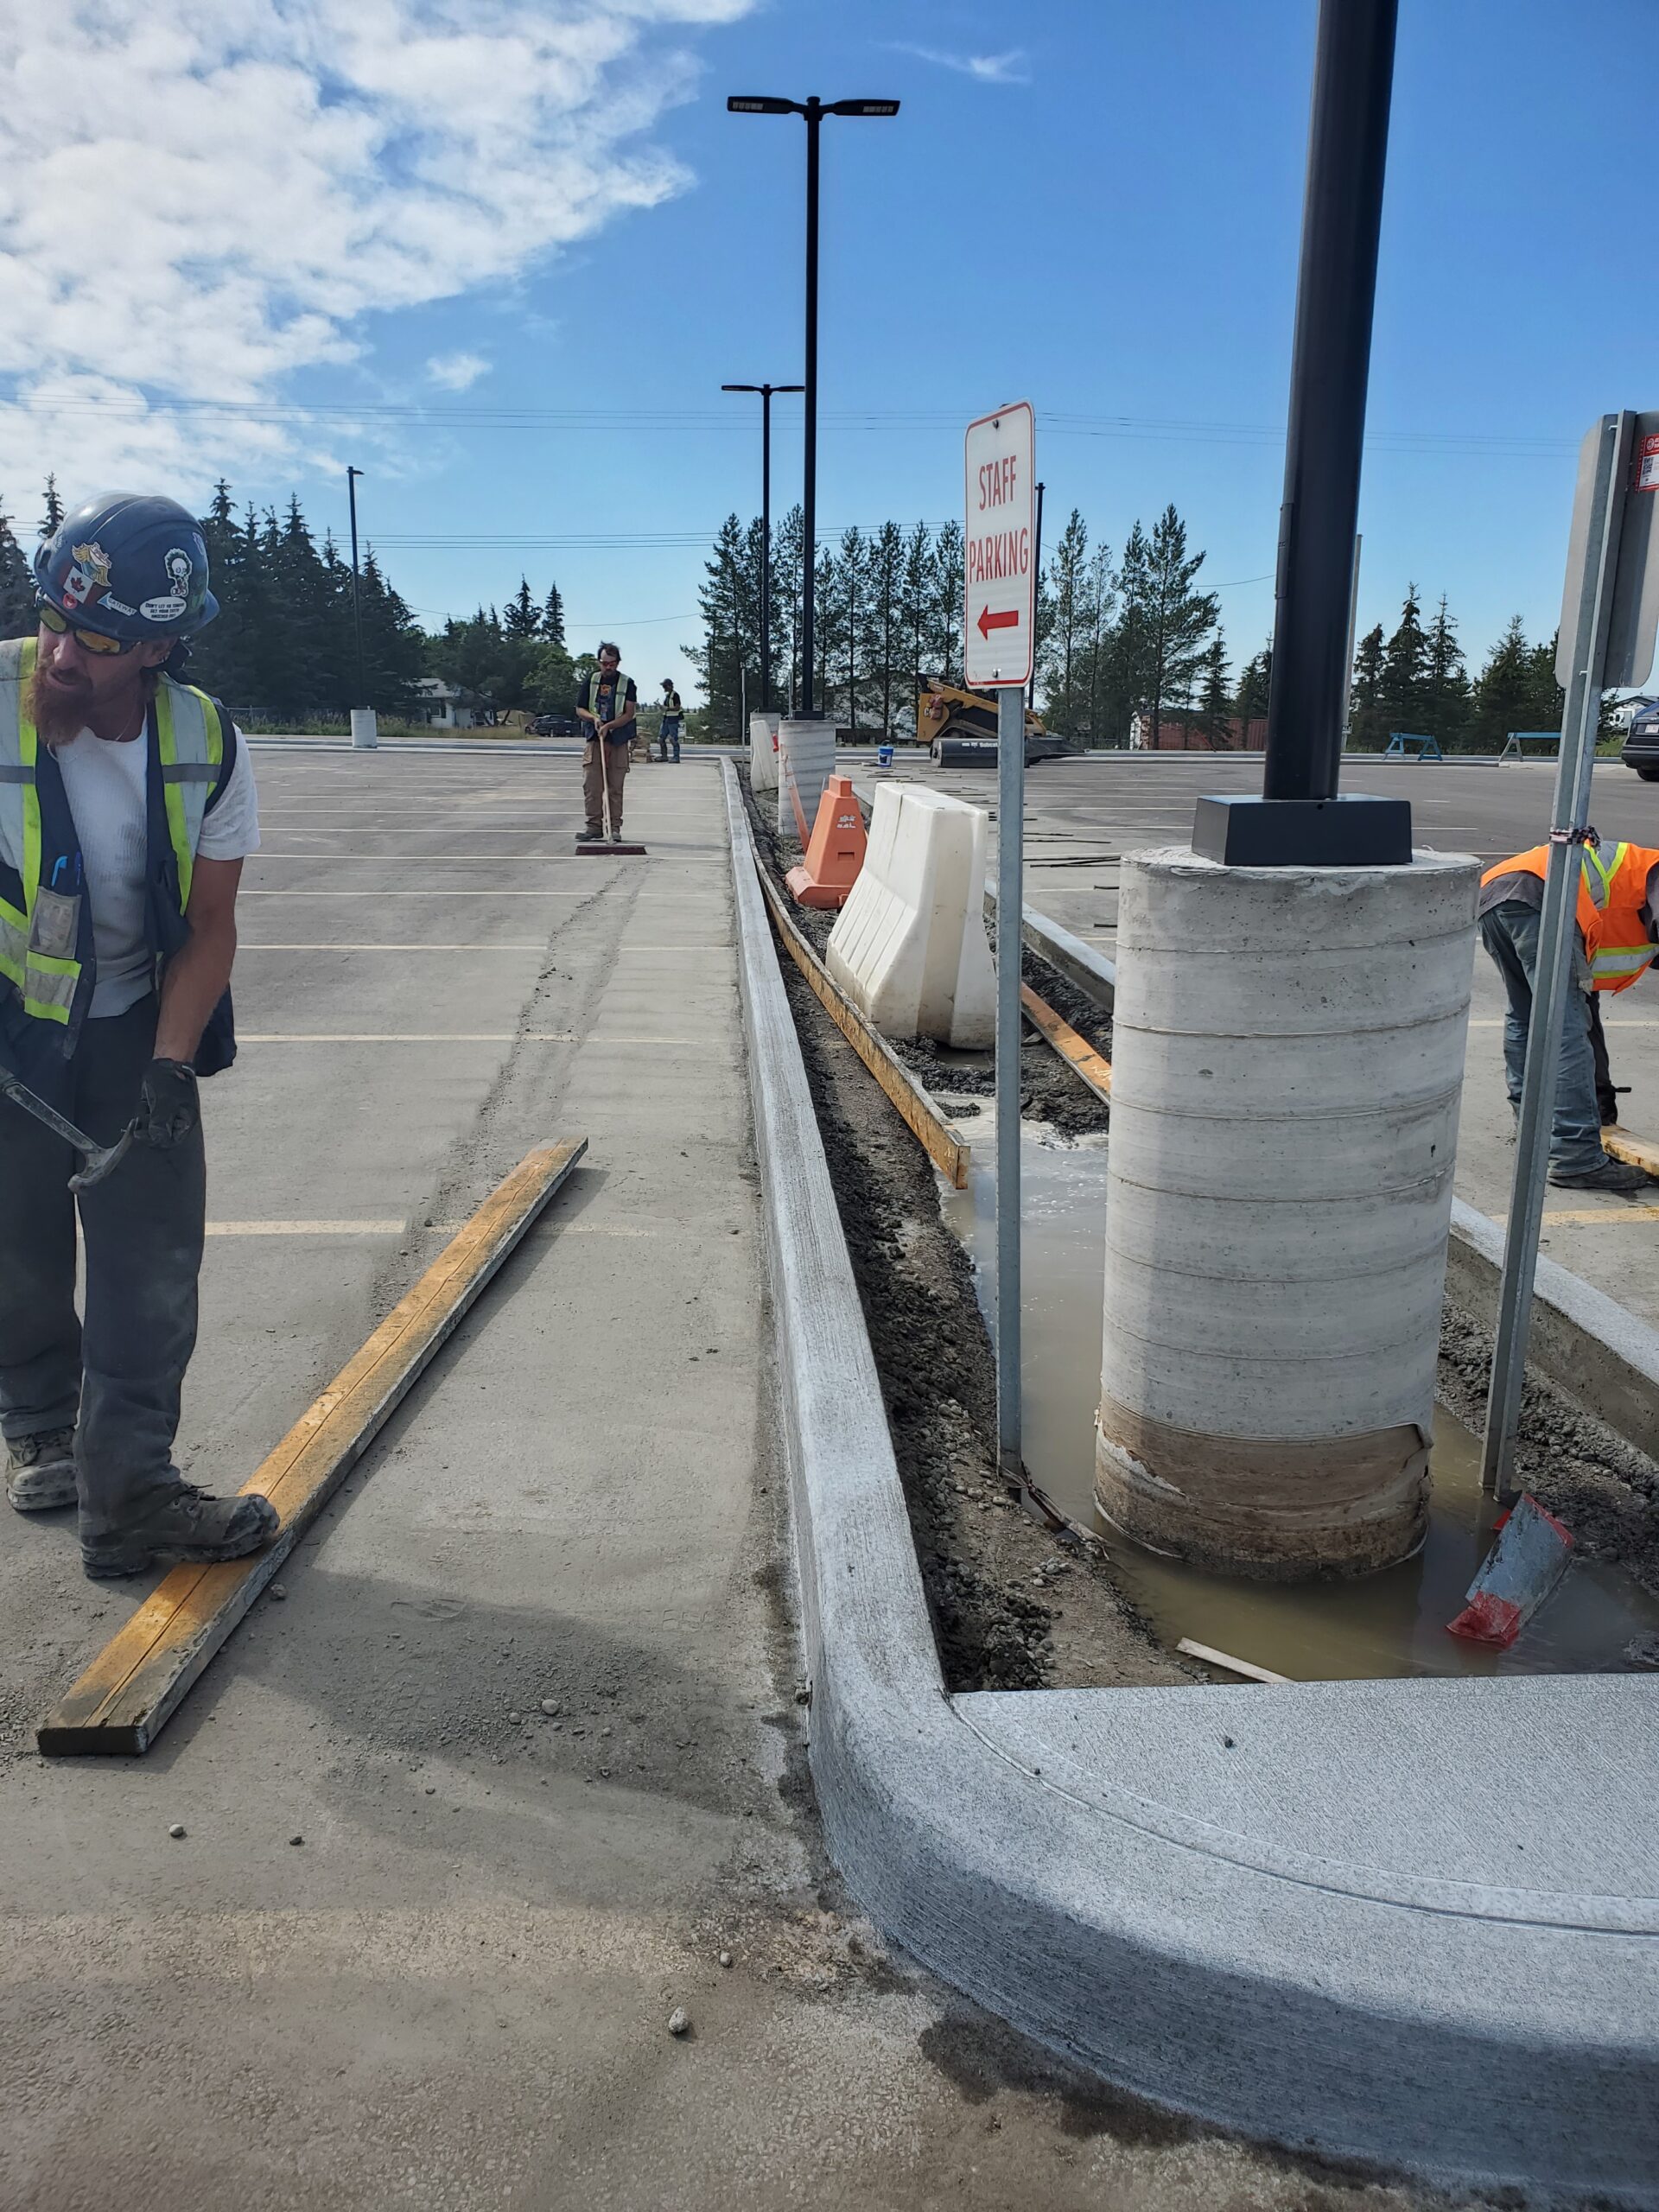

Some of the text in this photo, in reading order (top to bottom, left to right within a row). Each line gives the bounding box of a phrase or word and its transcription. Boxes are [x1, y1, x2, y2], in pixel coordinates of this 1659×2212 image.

[979, 455, 1017, 511] STAFF
[969, 527, 1028, 584] PARKING
[108, 598, 136, 614] GATEWAY
